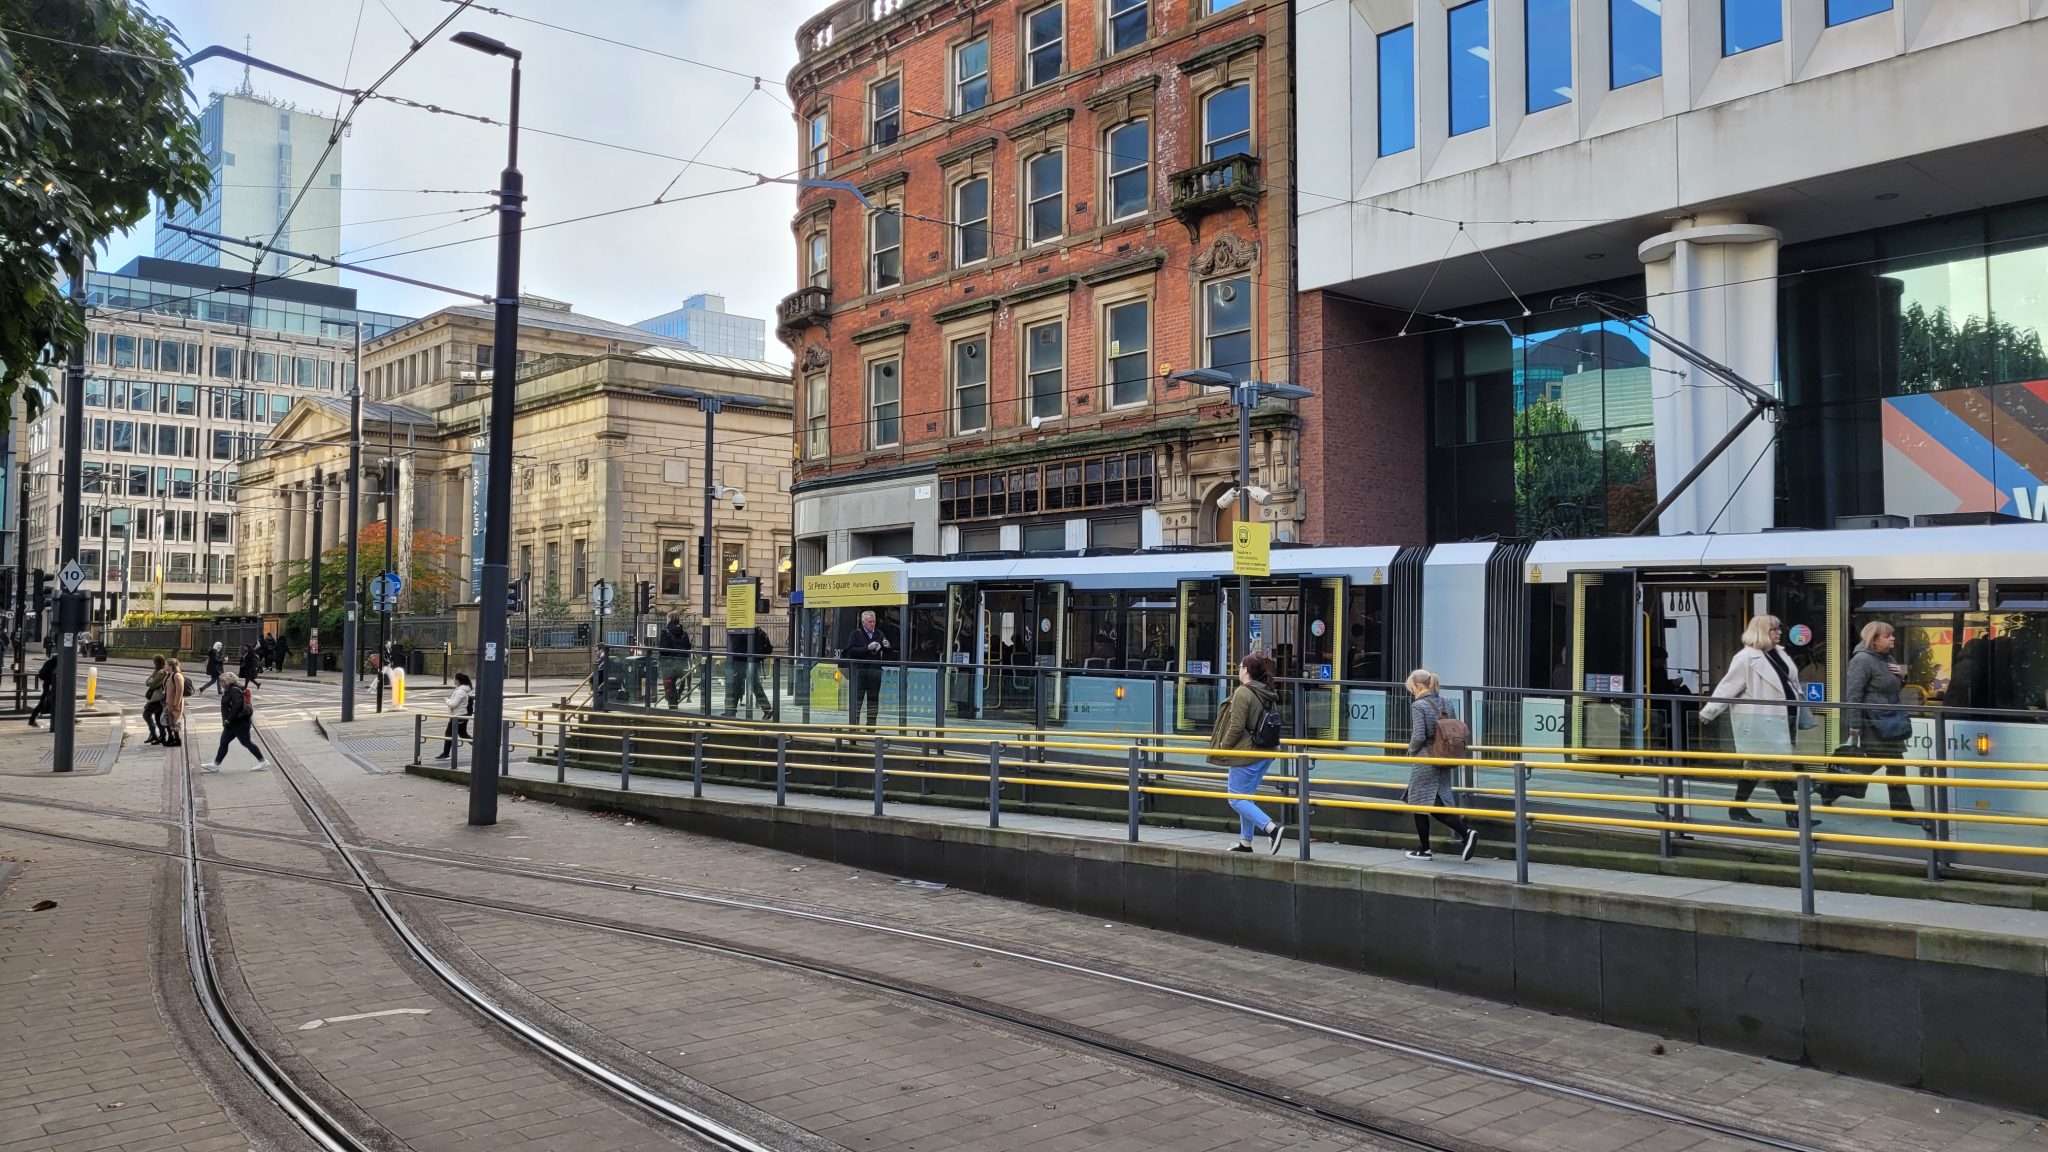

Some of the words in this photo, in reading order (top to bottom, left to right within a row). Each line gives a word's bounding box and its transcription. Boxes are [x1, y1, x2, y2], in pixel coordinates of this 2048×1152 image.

[64, 571, 80, 580] 10
[808, 581, 814, 590] St
[815, 580, 832, 590] Peter's
[832, 579, 851, 590] Square
[1534, 714, 1567, 733] 302
